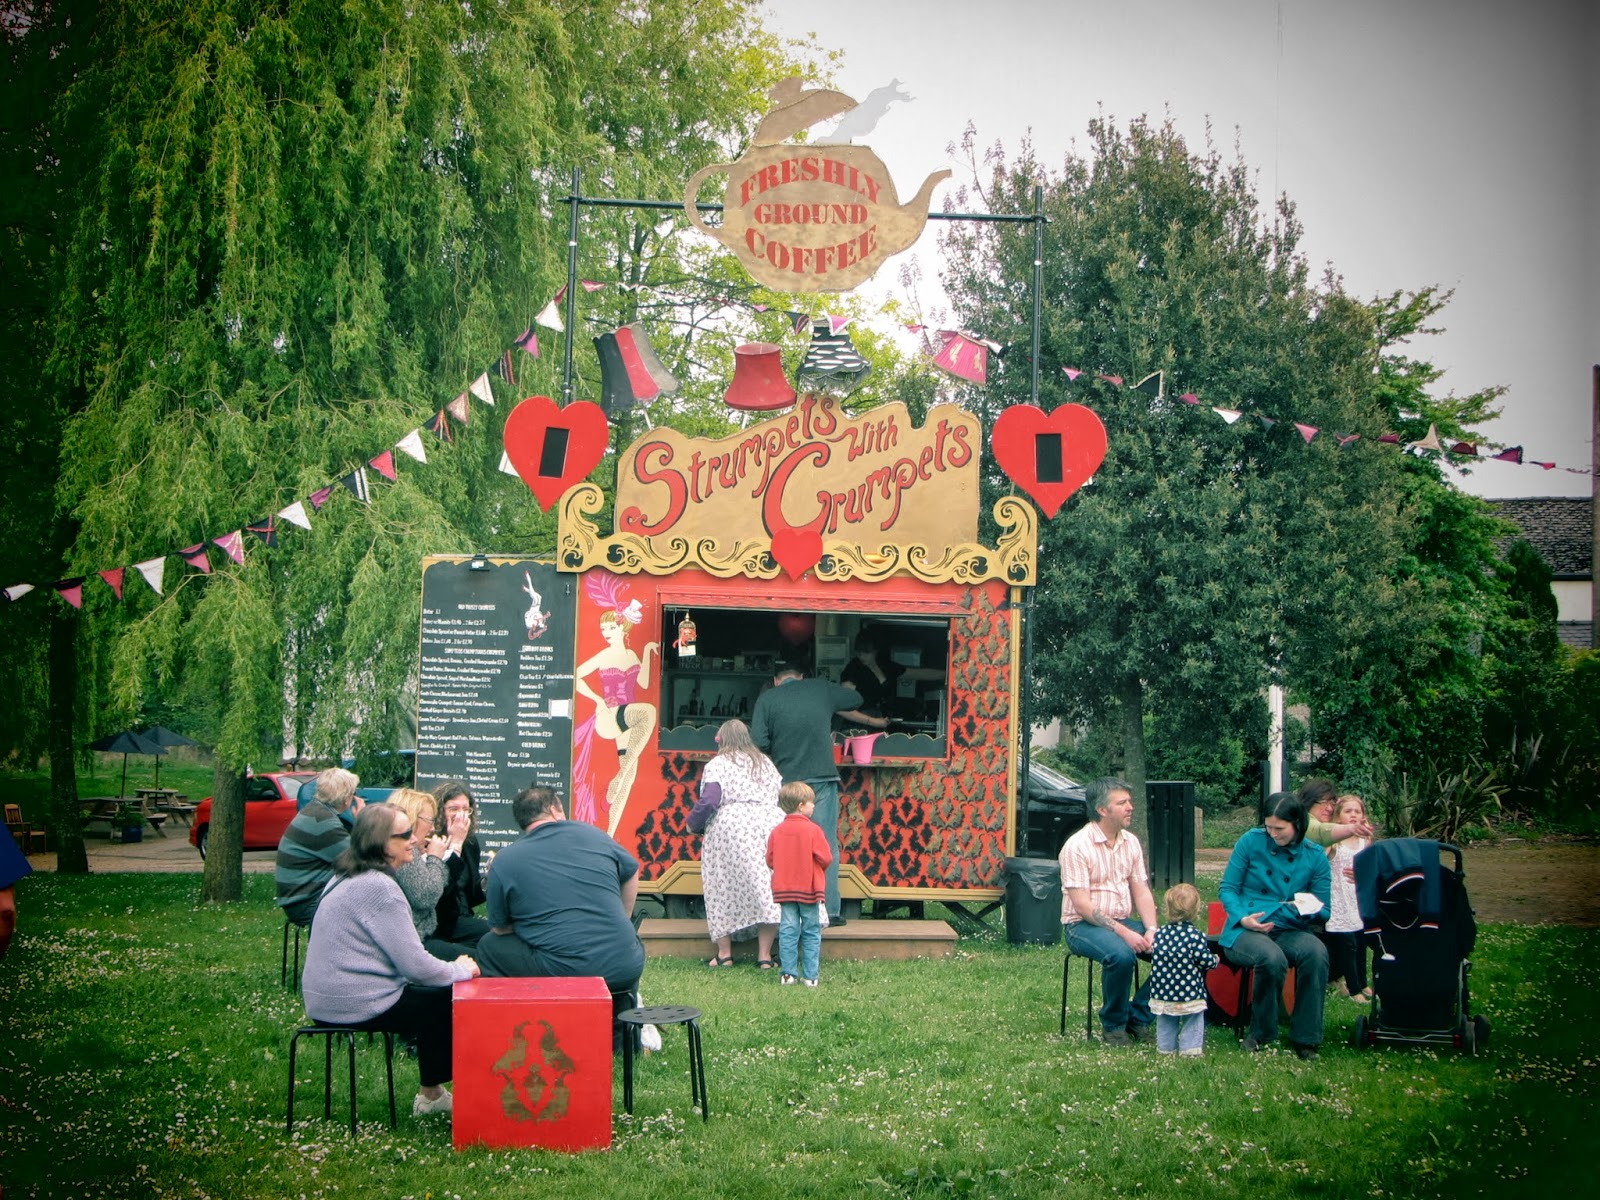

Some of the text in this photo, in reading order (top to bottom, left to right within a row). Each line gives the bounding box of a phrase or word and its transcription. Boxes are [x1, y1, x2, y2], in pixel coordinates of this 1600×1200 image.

[740, 157, 882, 207] FRESHLY
[754, 203, 868, 225] GROUND
[745, 224, 878, 274] COFFEE
[619, 391, 837, 537] Strumpets
[761, 418, 973, 540] Crumpets
